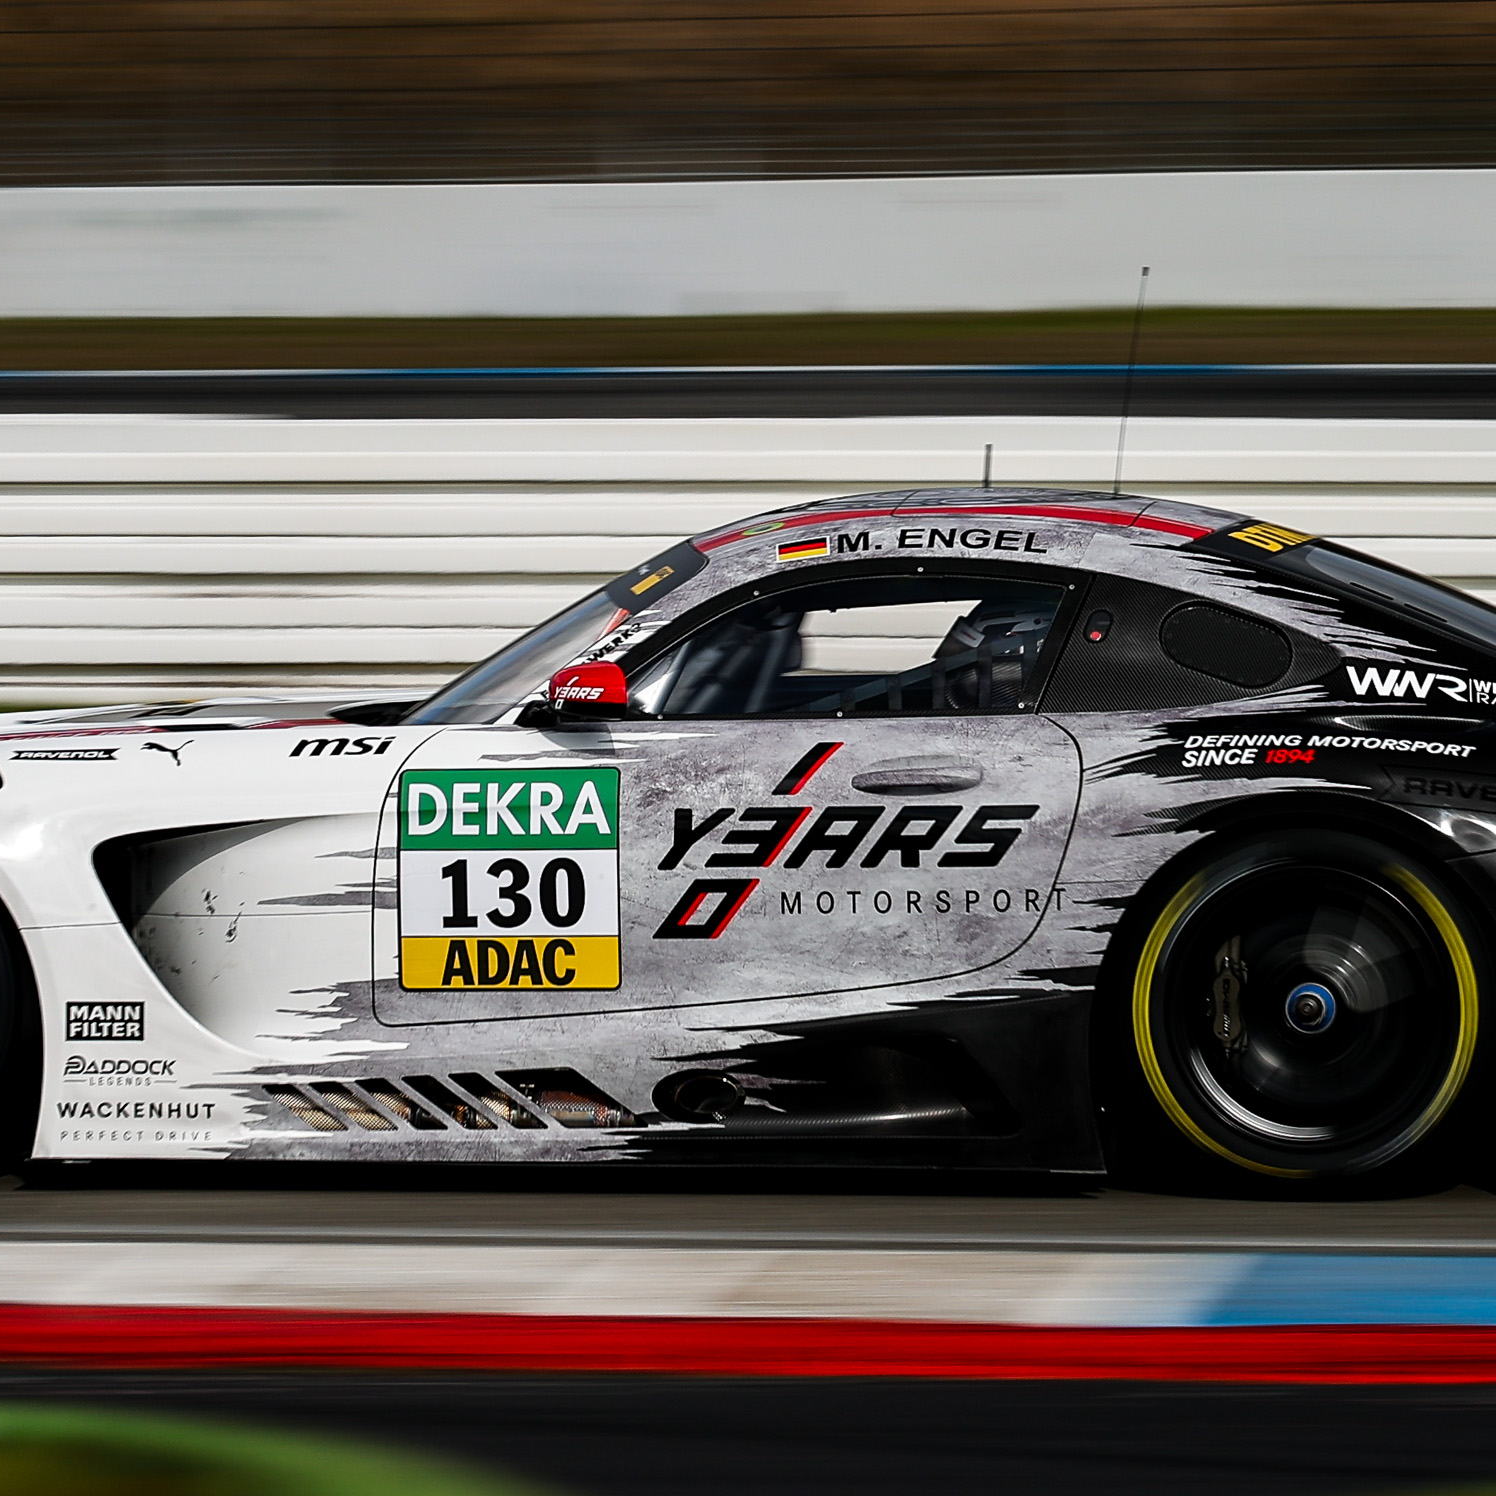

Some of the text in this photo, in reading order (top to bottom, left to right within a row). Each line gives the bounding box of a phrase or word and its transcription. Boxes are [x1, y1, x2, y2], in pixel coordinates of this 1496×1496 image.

[837, 528, 1048, 554] M. ENGEL
[20, 750, 110, 760] RAVENOL
[289, 736, 397, 758] msi
[1183, 734, 1477, 759] DEFINING MOTORSPORT
[1181, 748, 1316, 768] SINCE 1894
[407, 780, 611, 837] DEKRA
[440, 857, 587, 930] 130
[780, 887, 1068, 916] MOTORSPORT
[440, 938, 578, 987] ADAC
[69, 1005, 141, 1021] MANN
[69, 1022, 141, 1038] FILTER
[63, 1055, 177, 1077] PADDOCK
[89, 1077, 152, 1086] LEGENDS
[56, 1102, 216, 1119] WACKENHUT
[60, 1130, 213, 1142] PERFECT DRIVE
